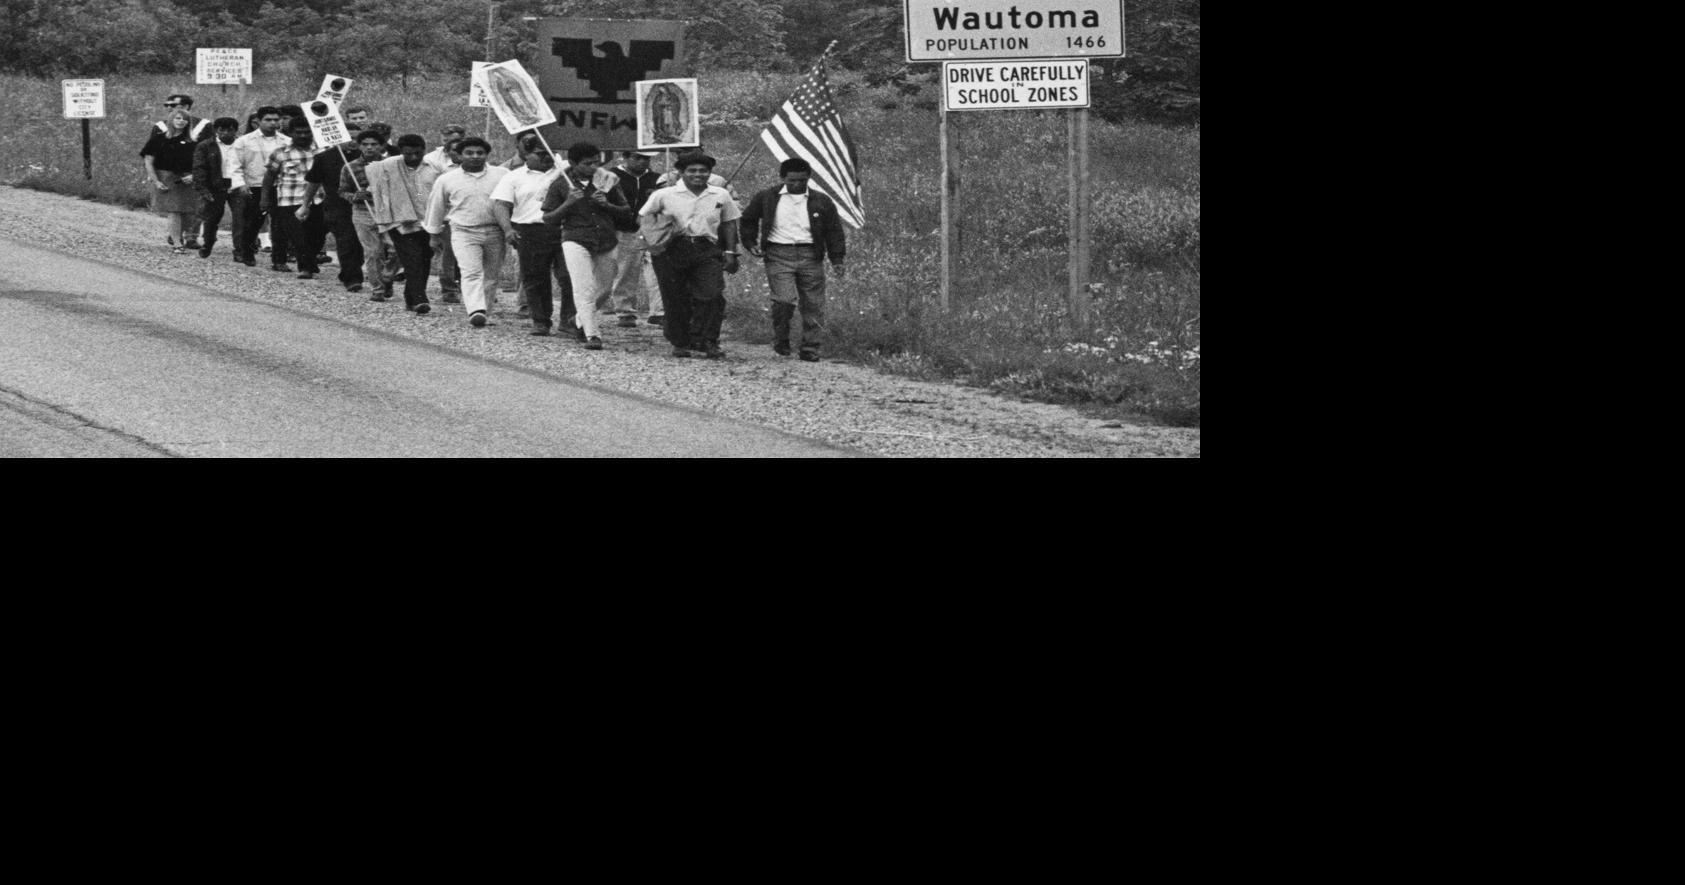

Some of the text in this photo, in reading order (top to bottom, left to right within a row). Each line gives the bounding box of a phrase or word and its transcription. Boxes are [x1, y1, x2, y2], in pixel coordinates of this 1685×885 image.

[933, 6, 1100, 30] Wautoma
[926, 35, 1106, 51] POPULATION 1466
[949, 65, 1084, 83] DRIVE CAREFULLY
[958, 87, 1079, 105] SCHOOL ZONES
